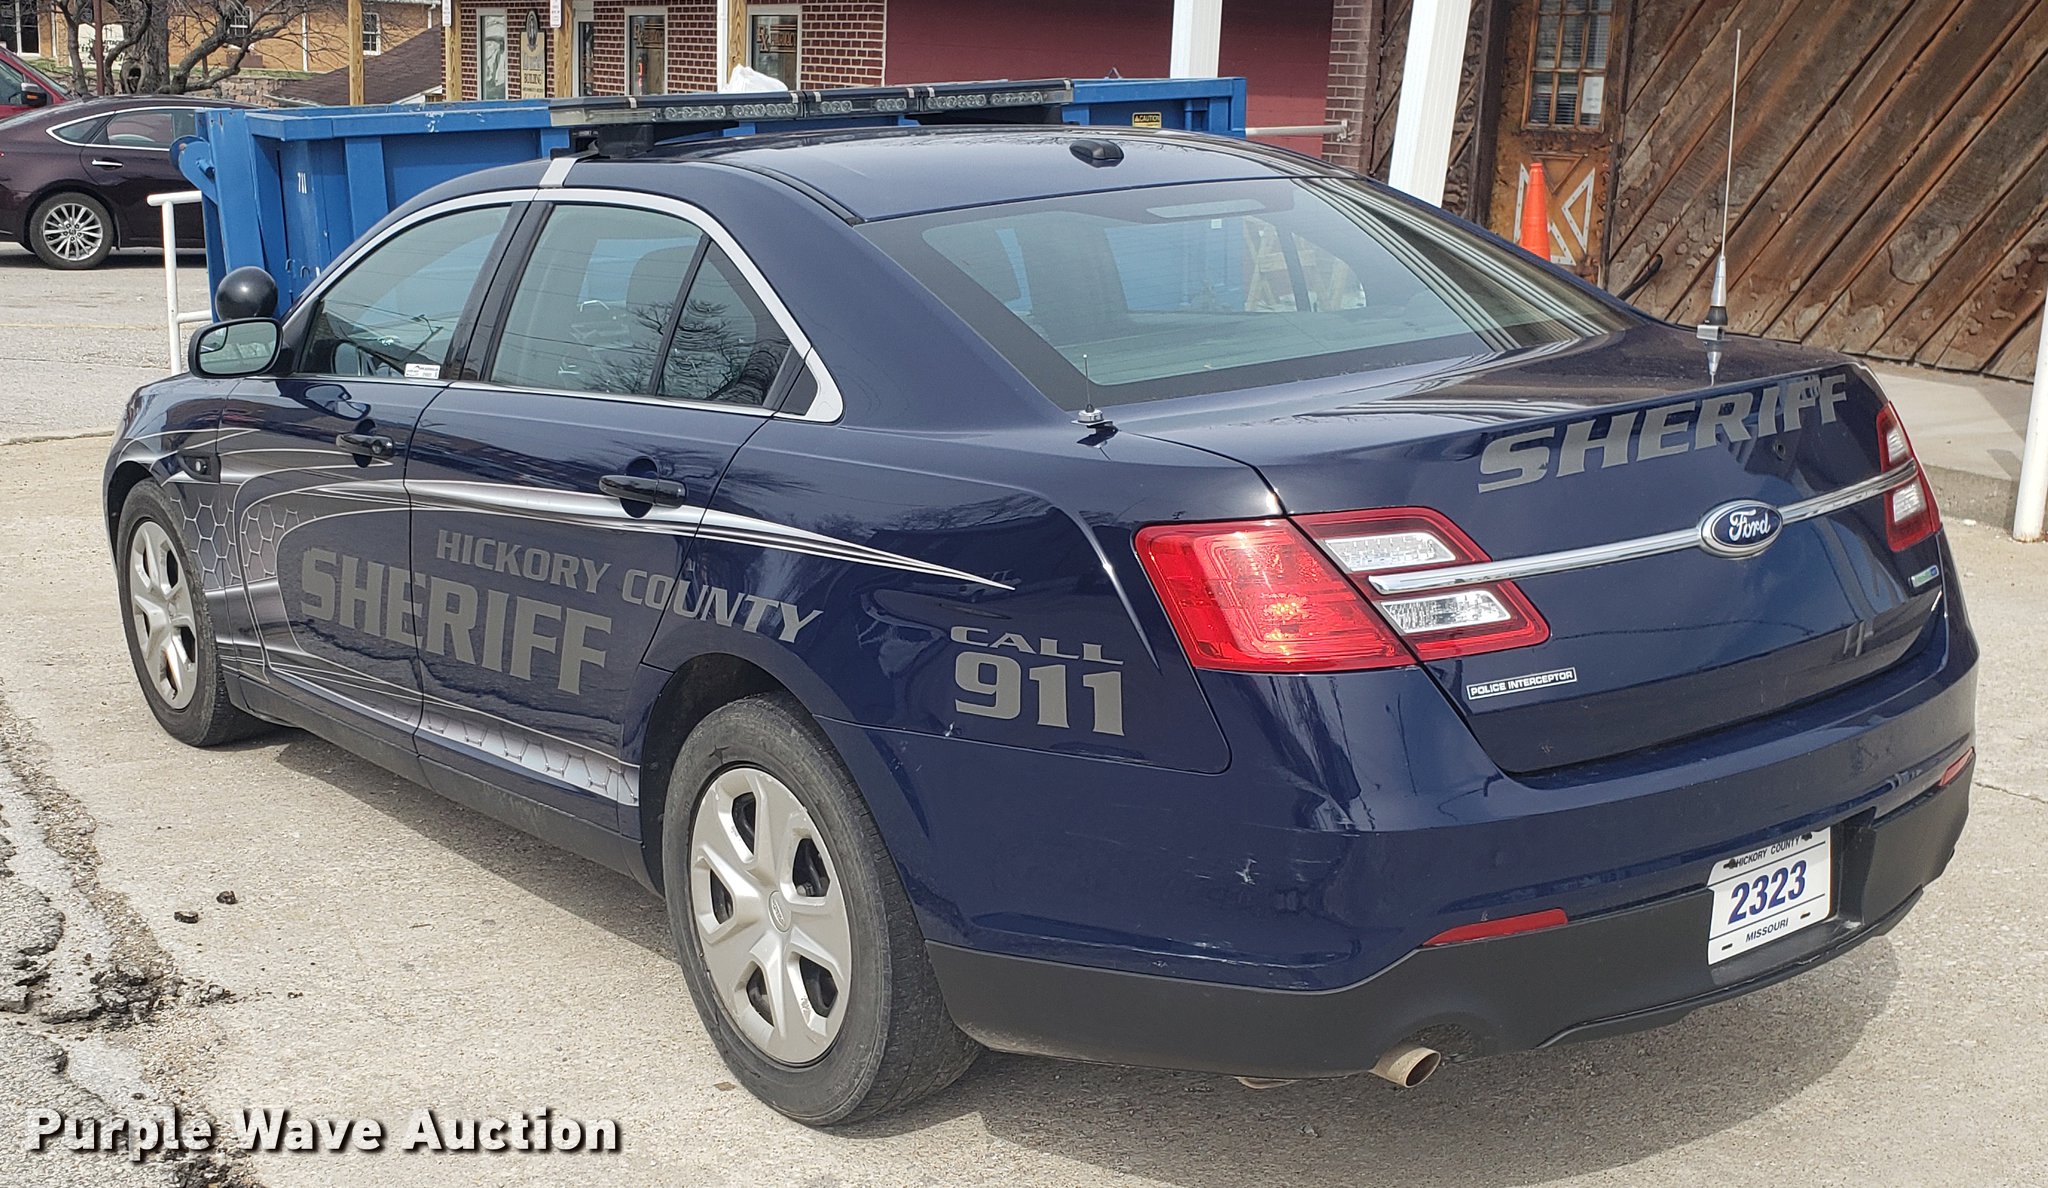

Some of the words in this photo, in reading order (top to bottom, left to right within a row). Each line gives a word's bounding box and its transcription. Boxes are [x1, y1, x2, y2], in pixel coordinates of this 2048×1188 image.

[1478, 374, 1848, 493] SHERIFF
[1728, 508, 1772, 542] Ford
[436, 528, 612, 595] HICKORY
[621, 569, 824, 644] COUNTY
[301, 545, 613, 697] SHERIFF
[950, 626, 1124, 666] CALL
[954, 651, 1126, 737] 911
[1470, 682, 1506, 696] POLICE
[1508, 671, 1573, 689] INTERCEPTOR
[1735, 848, 1768, 867] HICKORY
[1770, 836, 1801, 855] COUNTY
[1727, 859, 1808, 925] 2323
[1745, 917, 1789, 943] MISSOURI
